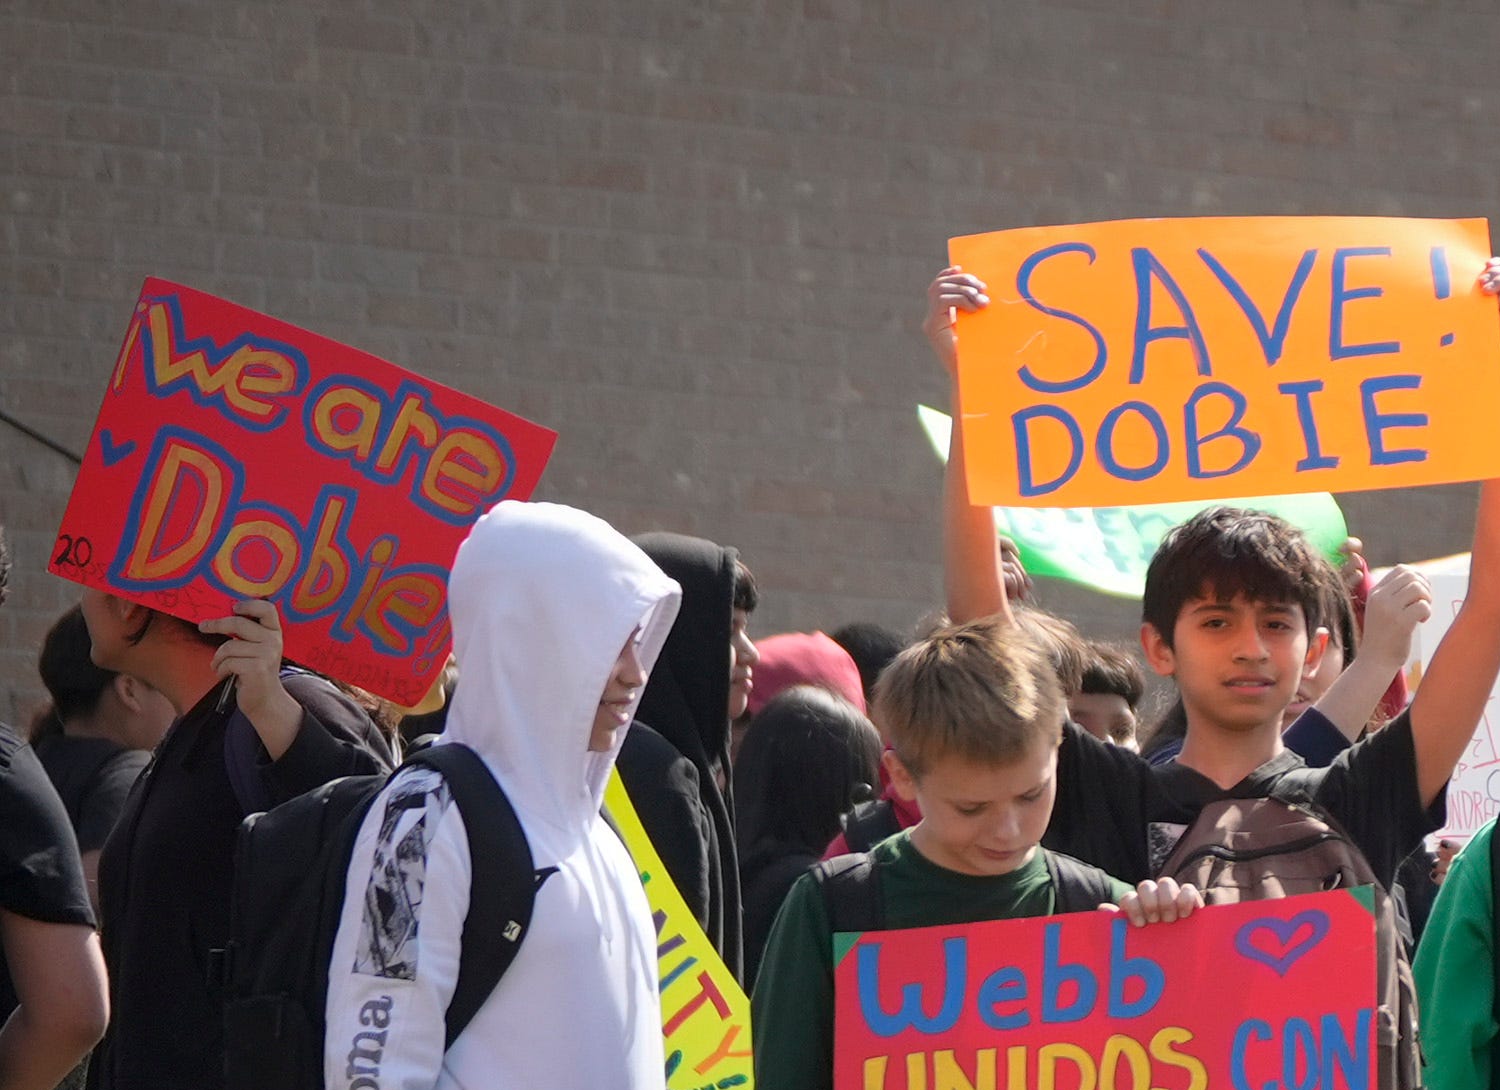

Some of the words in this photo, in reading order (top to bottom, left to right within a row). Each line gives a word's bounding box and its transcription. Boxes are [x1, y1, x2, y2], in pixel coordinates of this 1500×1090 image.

[1014, 241, 1455, 393] SAVE!
[303, 373, 517, 525] are
[1010, 374, 1429, 498] DOBIE
[55, 534, 92, 568] 20
[856, 919, 1166, 1037] Webb
